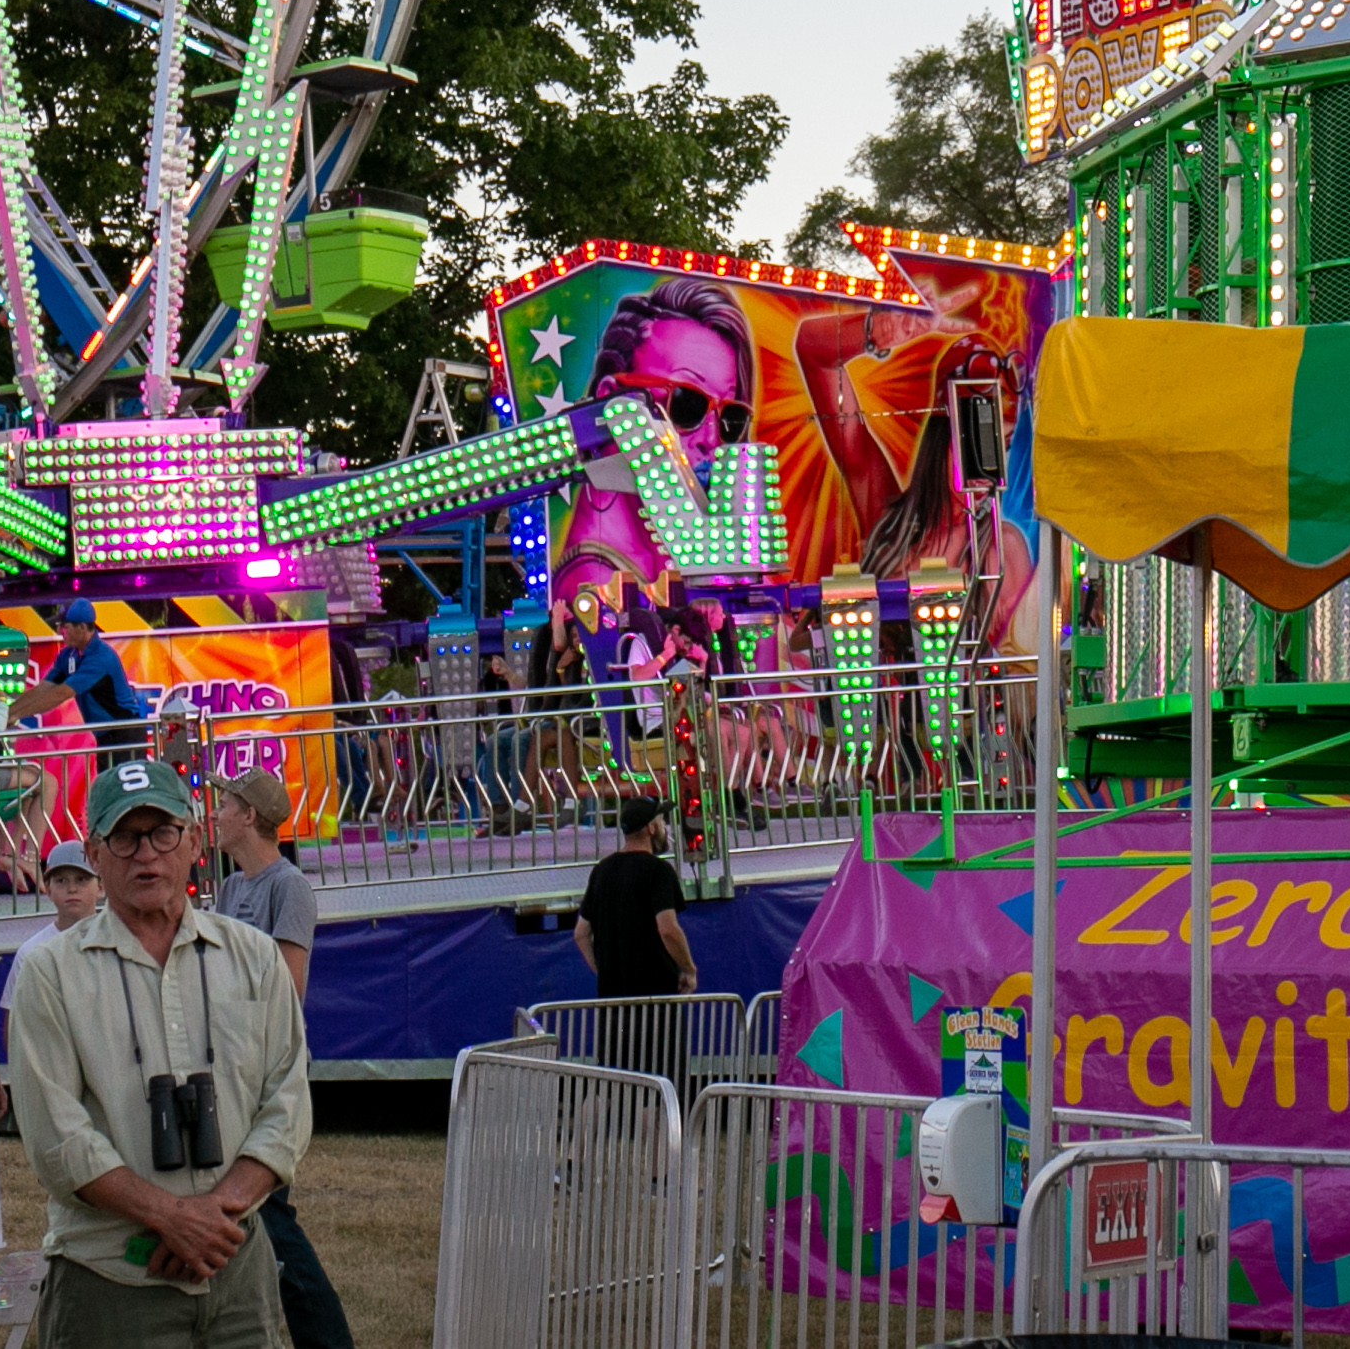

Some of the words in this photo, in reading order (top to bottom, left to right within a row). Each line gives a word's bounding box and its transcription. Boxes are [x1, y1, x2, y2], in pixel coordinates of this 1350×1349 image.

[319, 192, 331, 211] 5
[129, 679, 288, 720] ECHNO
[1236, 724, 1246, 752] 6
[118, 763, 151, 792] S
[947, 1011, 980, 1036] Clean
[982, 1006, 1019, 1039] Hands
[964, 1029, 1002, 1050] Station
